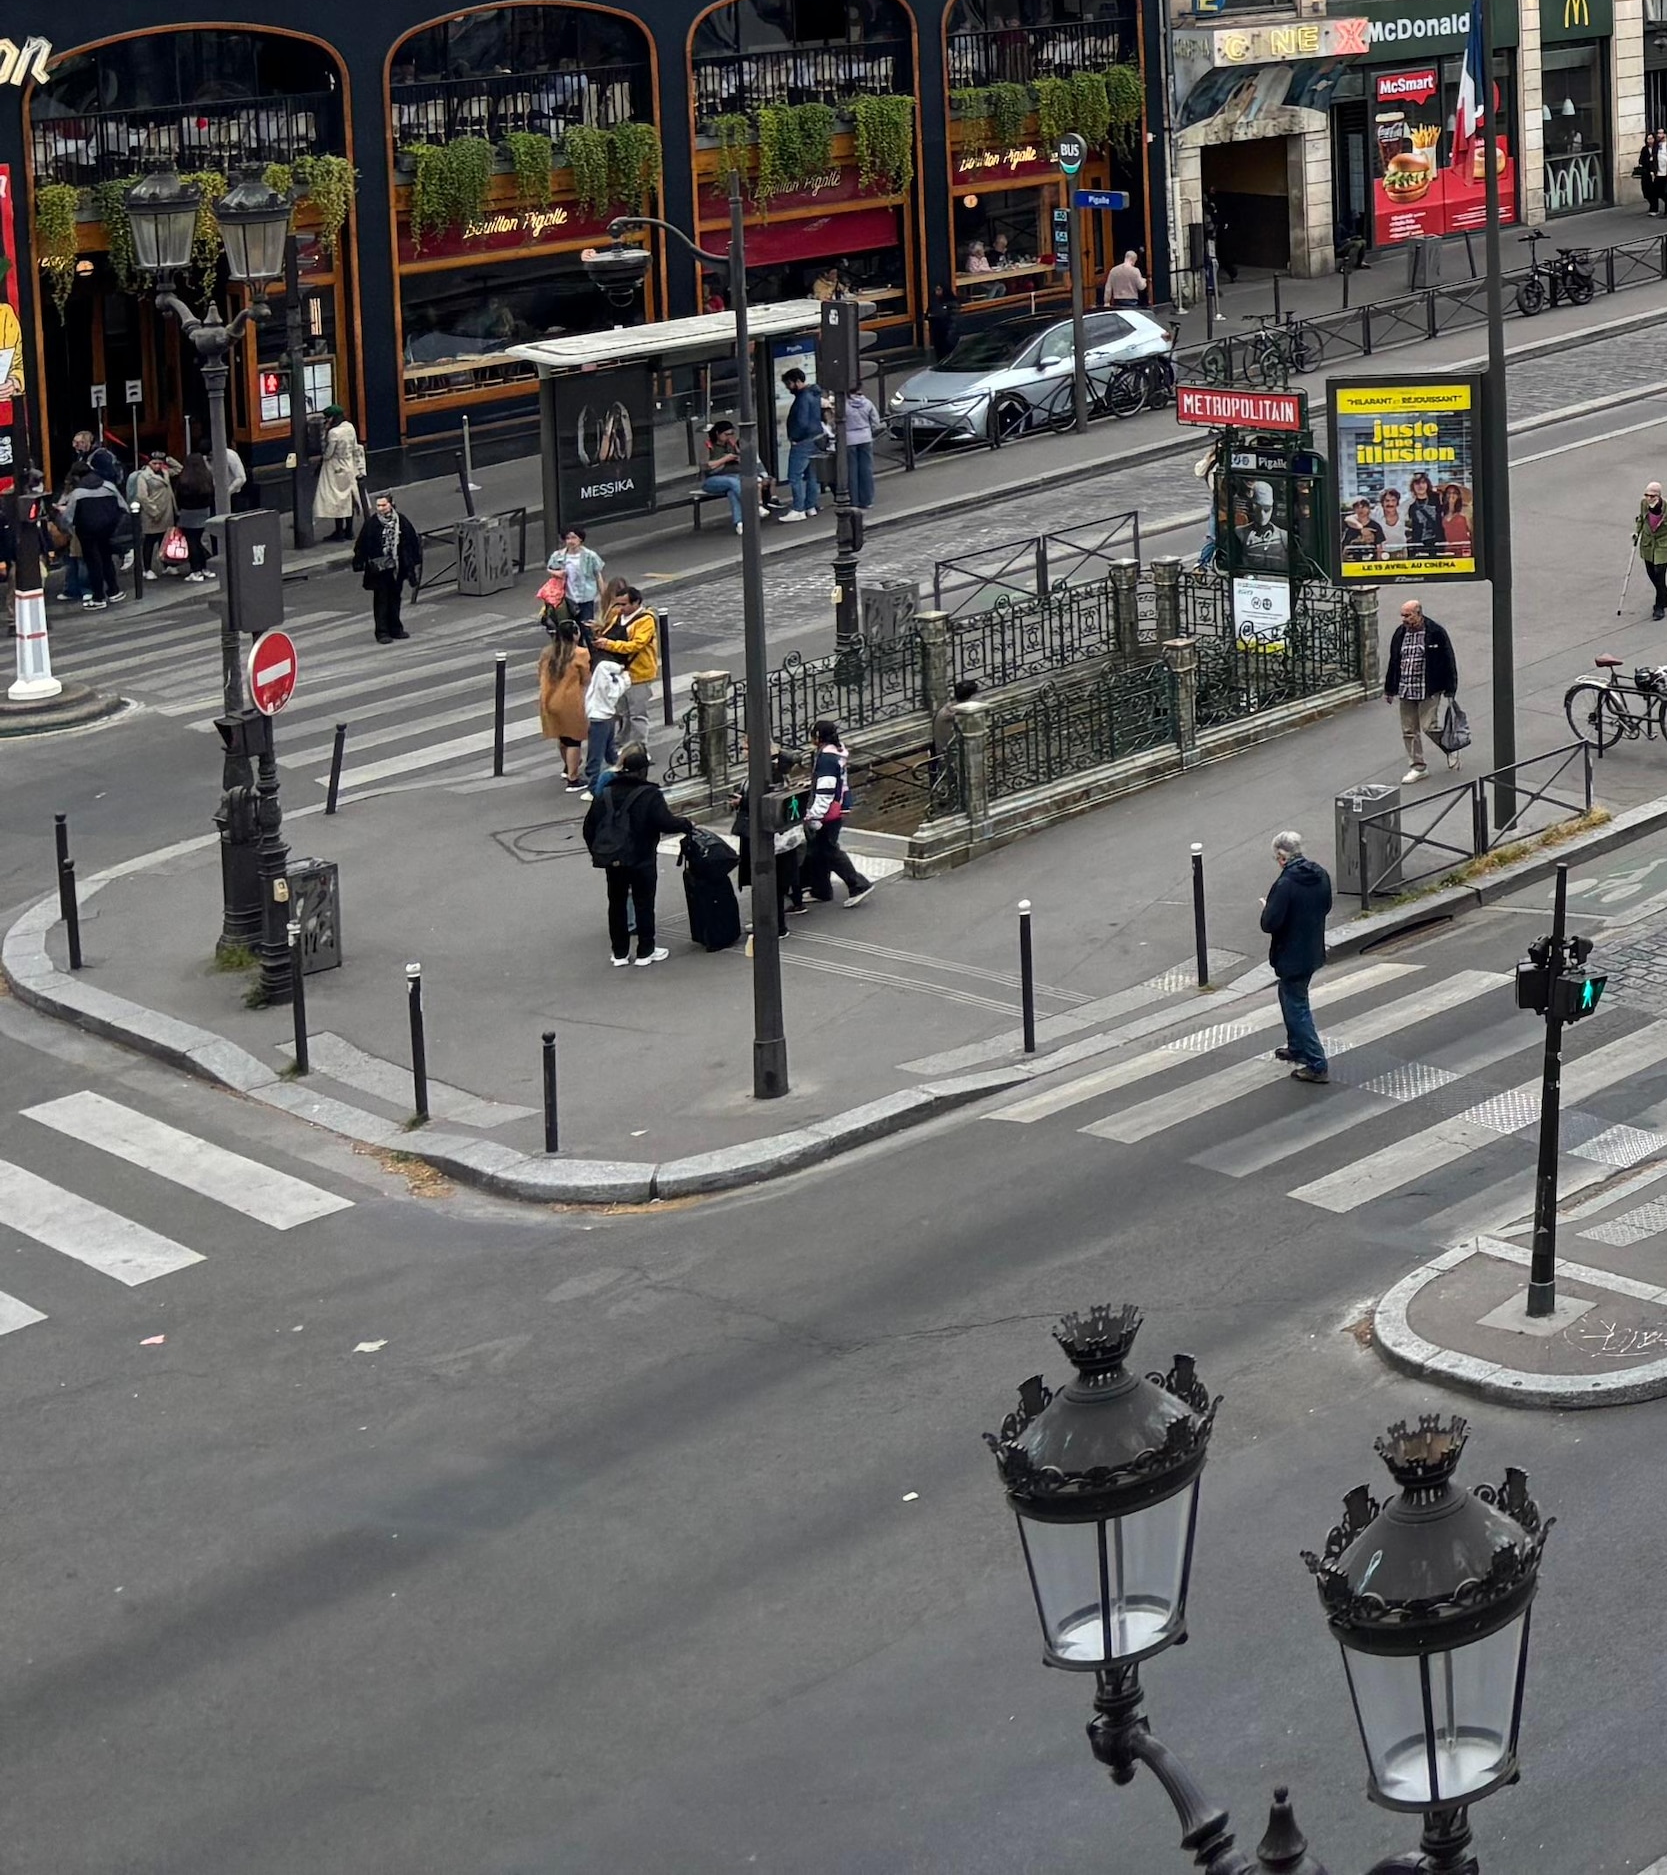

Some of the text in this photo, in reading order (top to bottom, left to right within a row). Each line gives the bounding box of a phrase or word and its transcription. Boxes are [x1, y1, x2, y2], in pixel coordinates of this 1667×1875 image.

[1334, 18, 1369, 55] X
[1379, 74, 1434, 96] McSmart
[1003, 145, 1037, 171] Pigalle
[1060, 143, 1080, 157] BUS
[1088, 195, 1111, 206] Pigalle
[522, 207, 568, 238] Pigalle
[1183, 393, 1295, 423] METROPOLITAIN
[1372, 419, 1439, 444] juste
[1356, 442, 1456, 464] illusion
[580, 477, 635, 500] MESSIKA
[1424, 561, 1456, 569] CINÉMA
